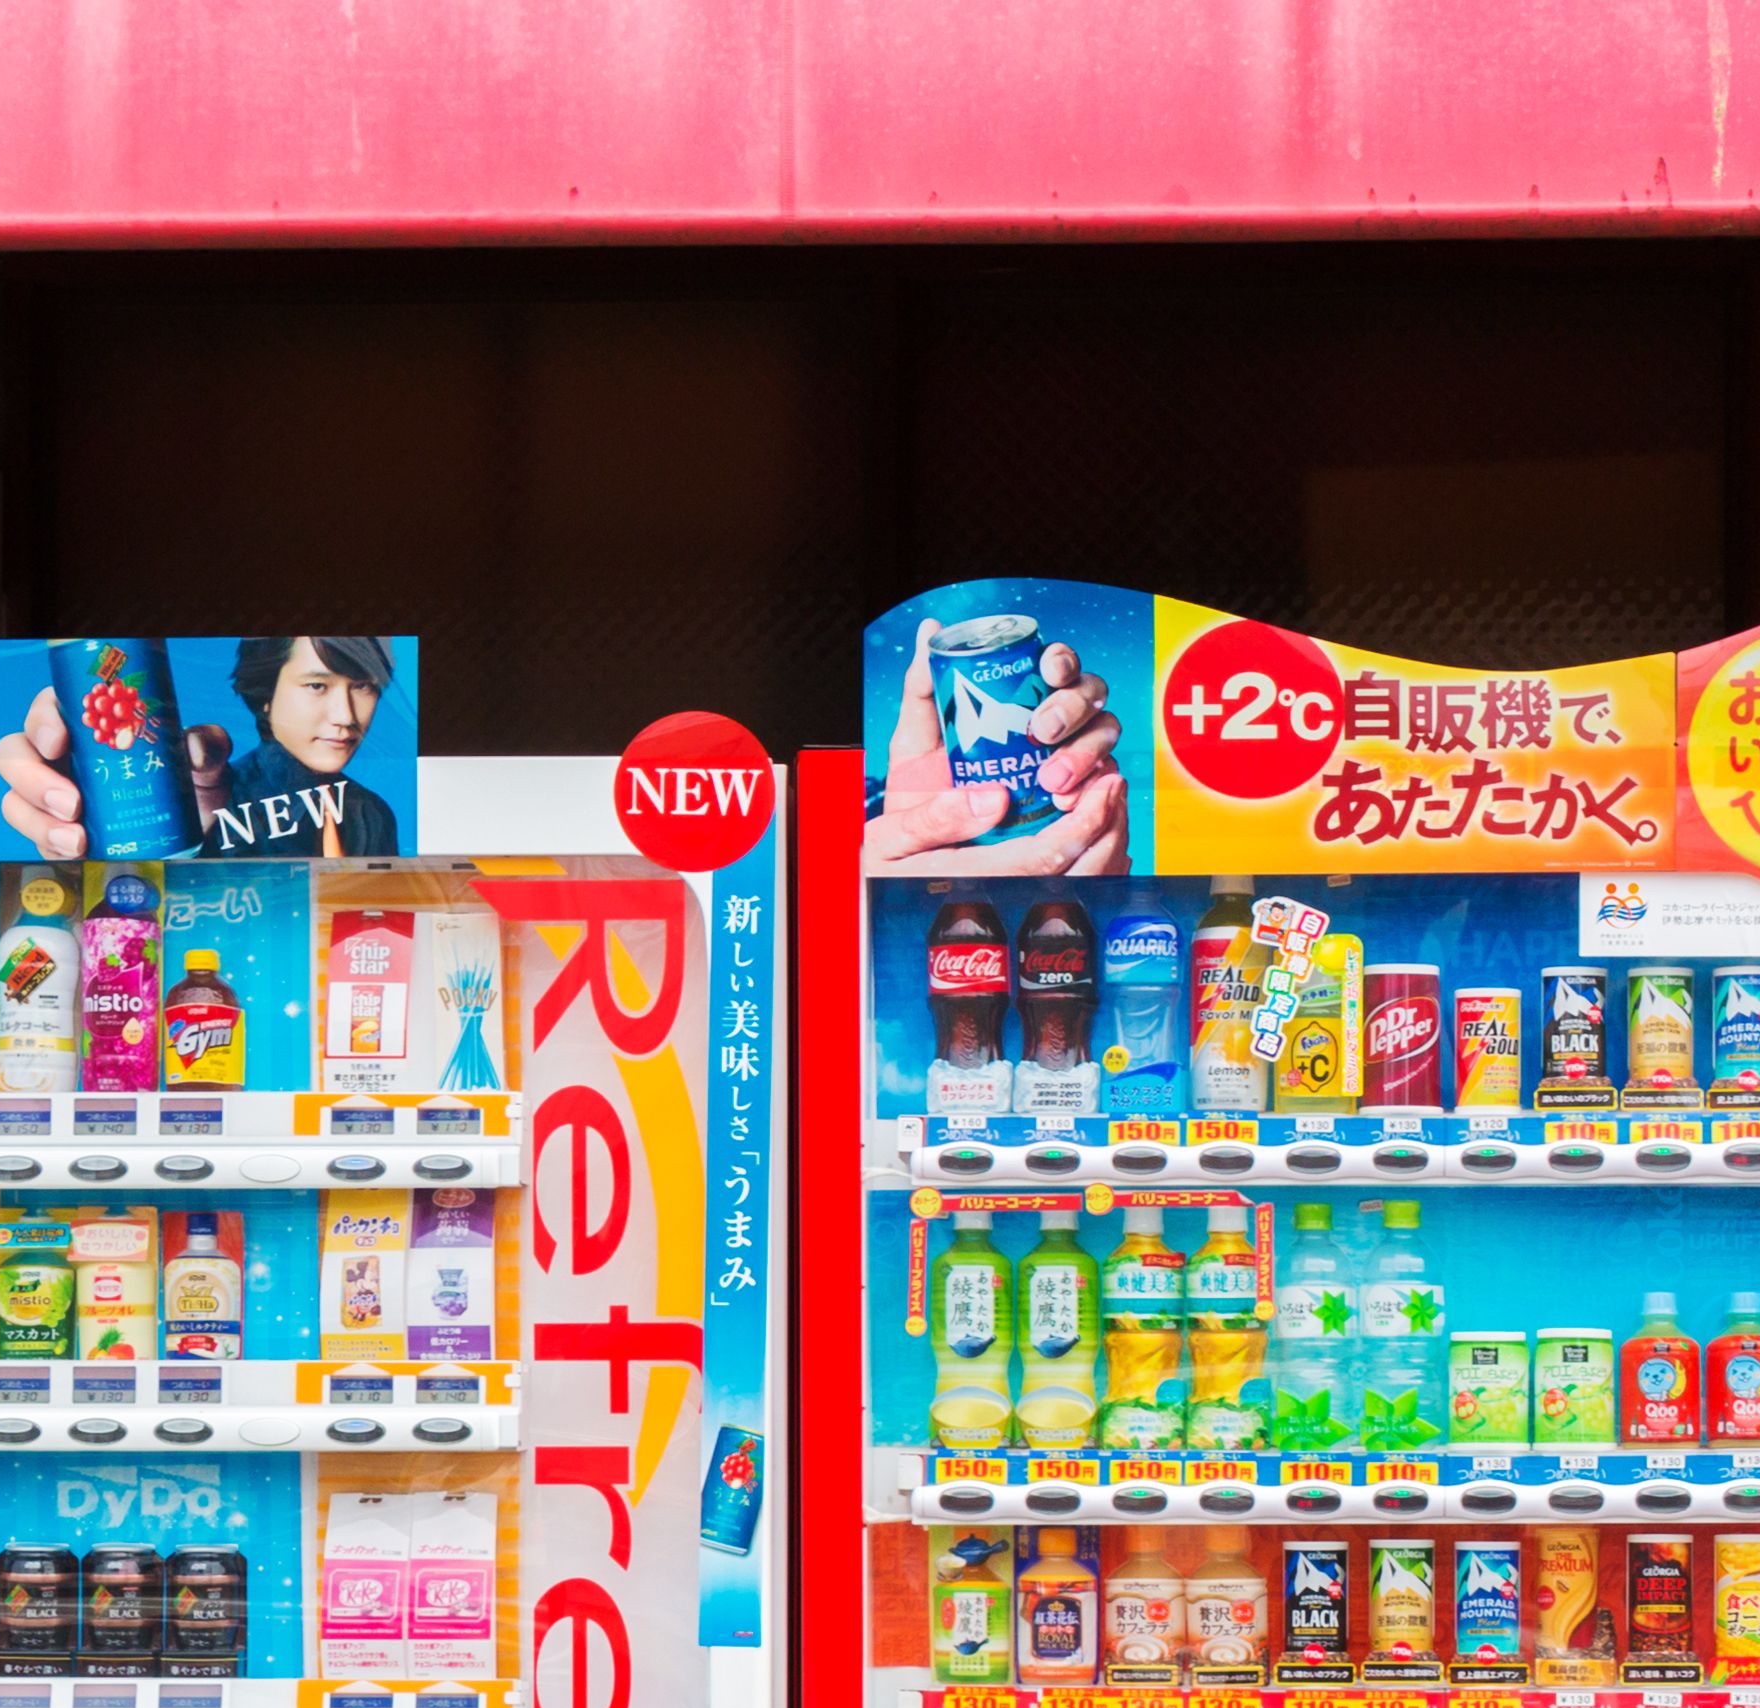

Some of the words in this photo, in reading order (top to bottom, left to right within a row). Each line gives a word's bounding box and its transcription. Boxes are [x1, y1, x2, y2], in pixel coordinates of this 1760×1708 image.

[1343, 671, 1622, 754] 自販機で、
[93, 749, 167, 786] うまみ
[108, 780, 155, 801] Blend
[625, 767, 762, 816] NEW
[1313, 758, 1658, 847] あたたかく。
[212, 779, 349, 851] NEW
[351, 943, 390, 964] chip
[350, 957, 390, 976] star
[1039, 970, 1074, 984] zero
[1199, 967, 1244, 986] REAL
[1551, 1032, 1600, 1053] BLACK
[710, 894, 763, 1306] 新しい美味しさ「うまみ」
[1114, 1122, 1177, 1141] 150円
[960, 1196, 1058, 1210] バリューコーナー
